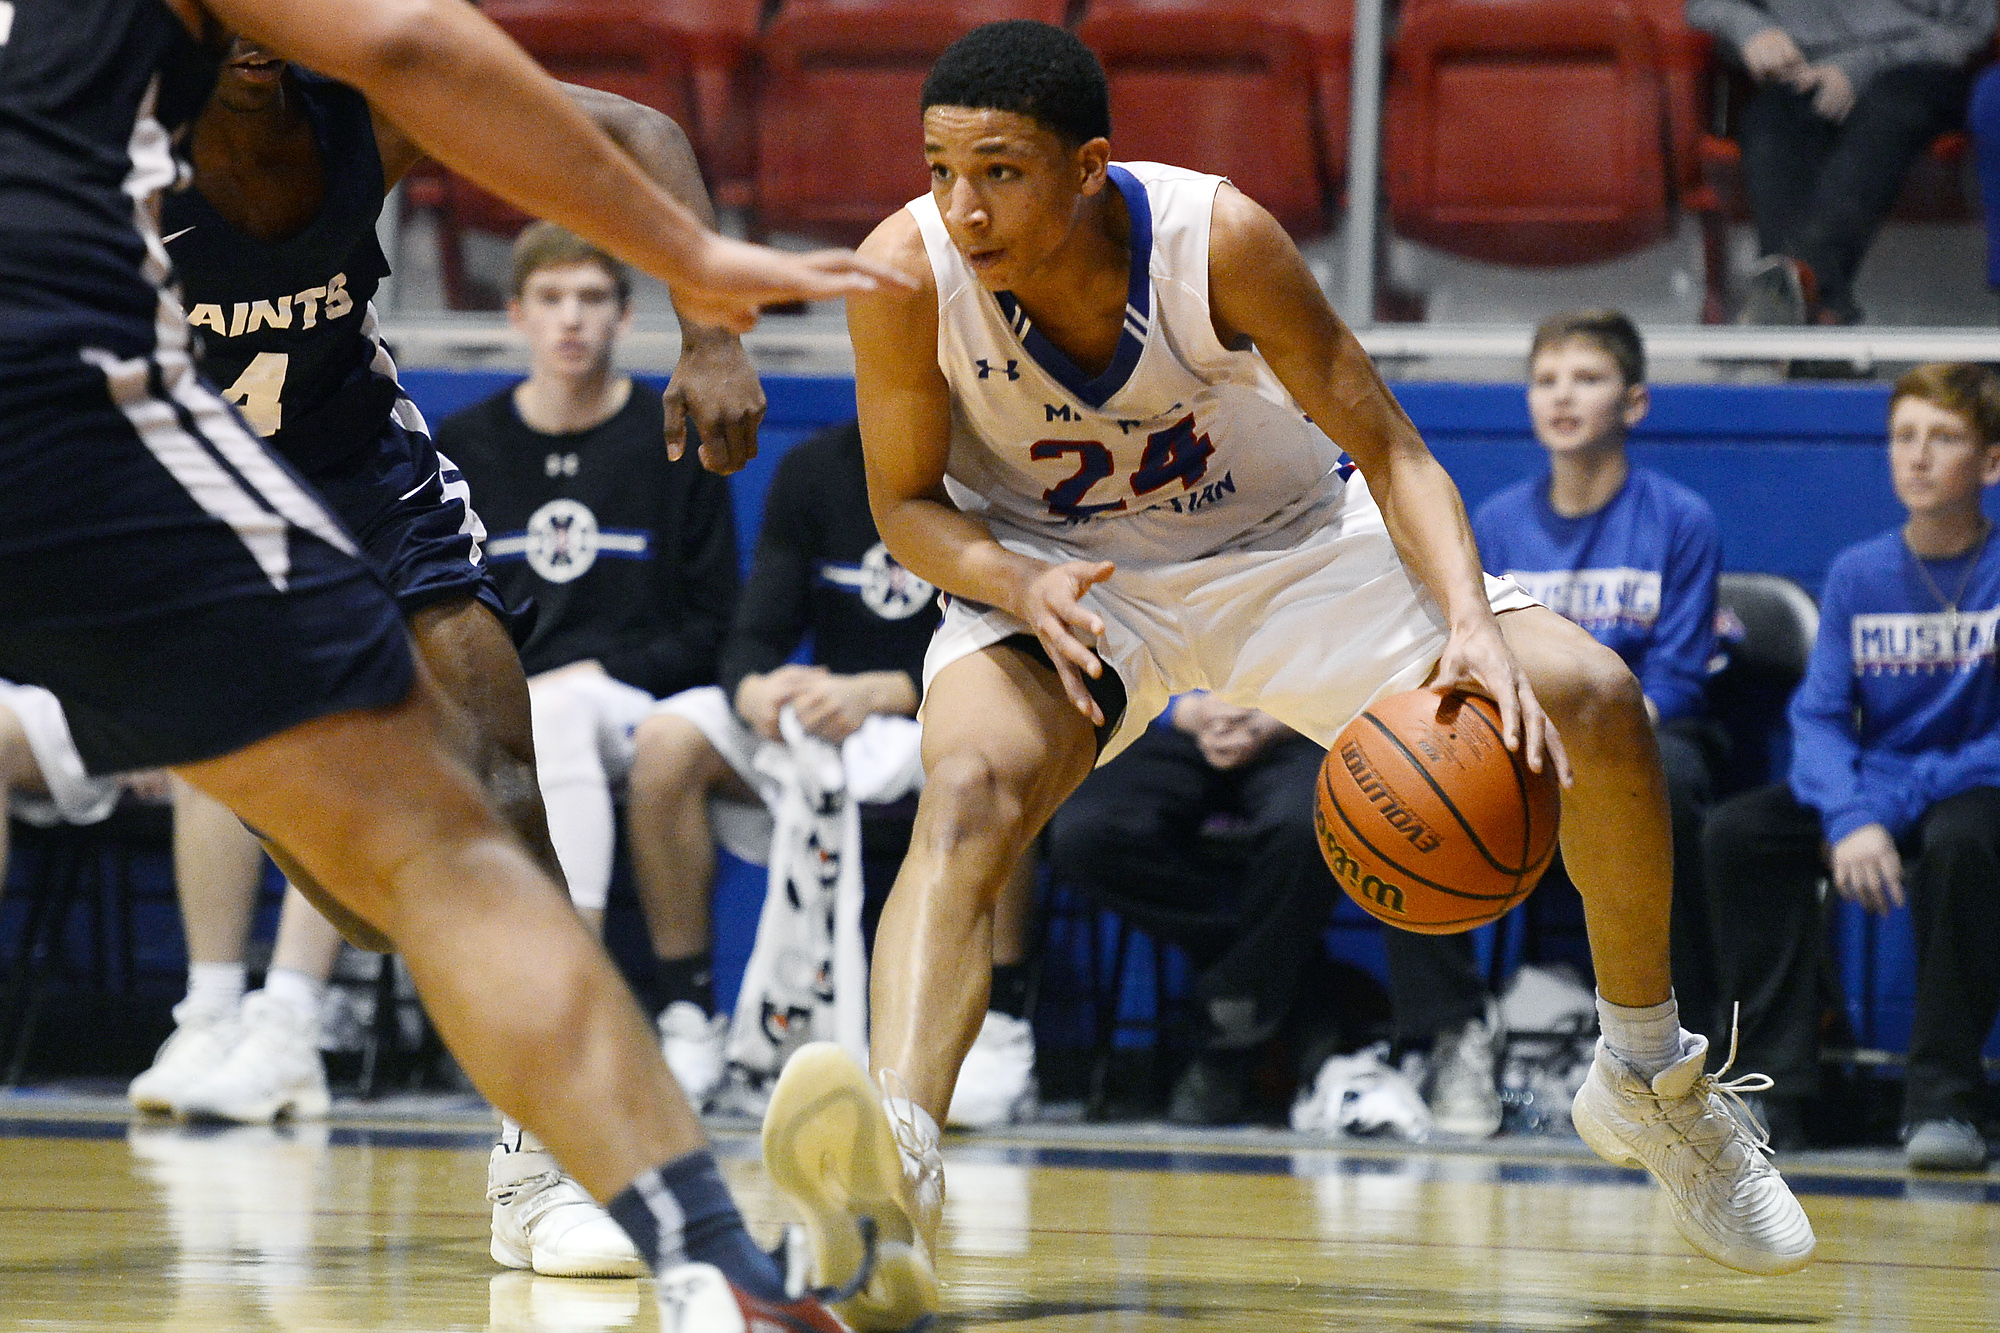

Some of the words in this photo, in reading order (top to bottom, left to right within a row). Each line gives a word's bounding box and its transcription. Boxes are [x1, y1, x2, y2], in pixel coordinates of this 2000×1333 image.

[187, 272, 353, 338] AINTS
[221, 352, 289, 437] 4
[1030, 412, 1216, 517] 24
